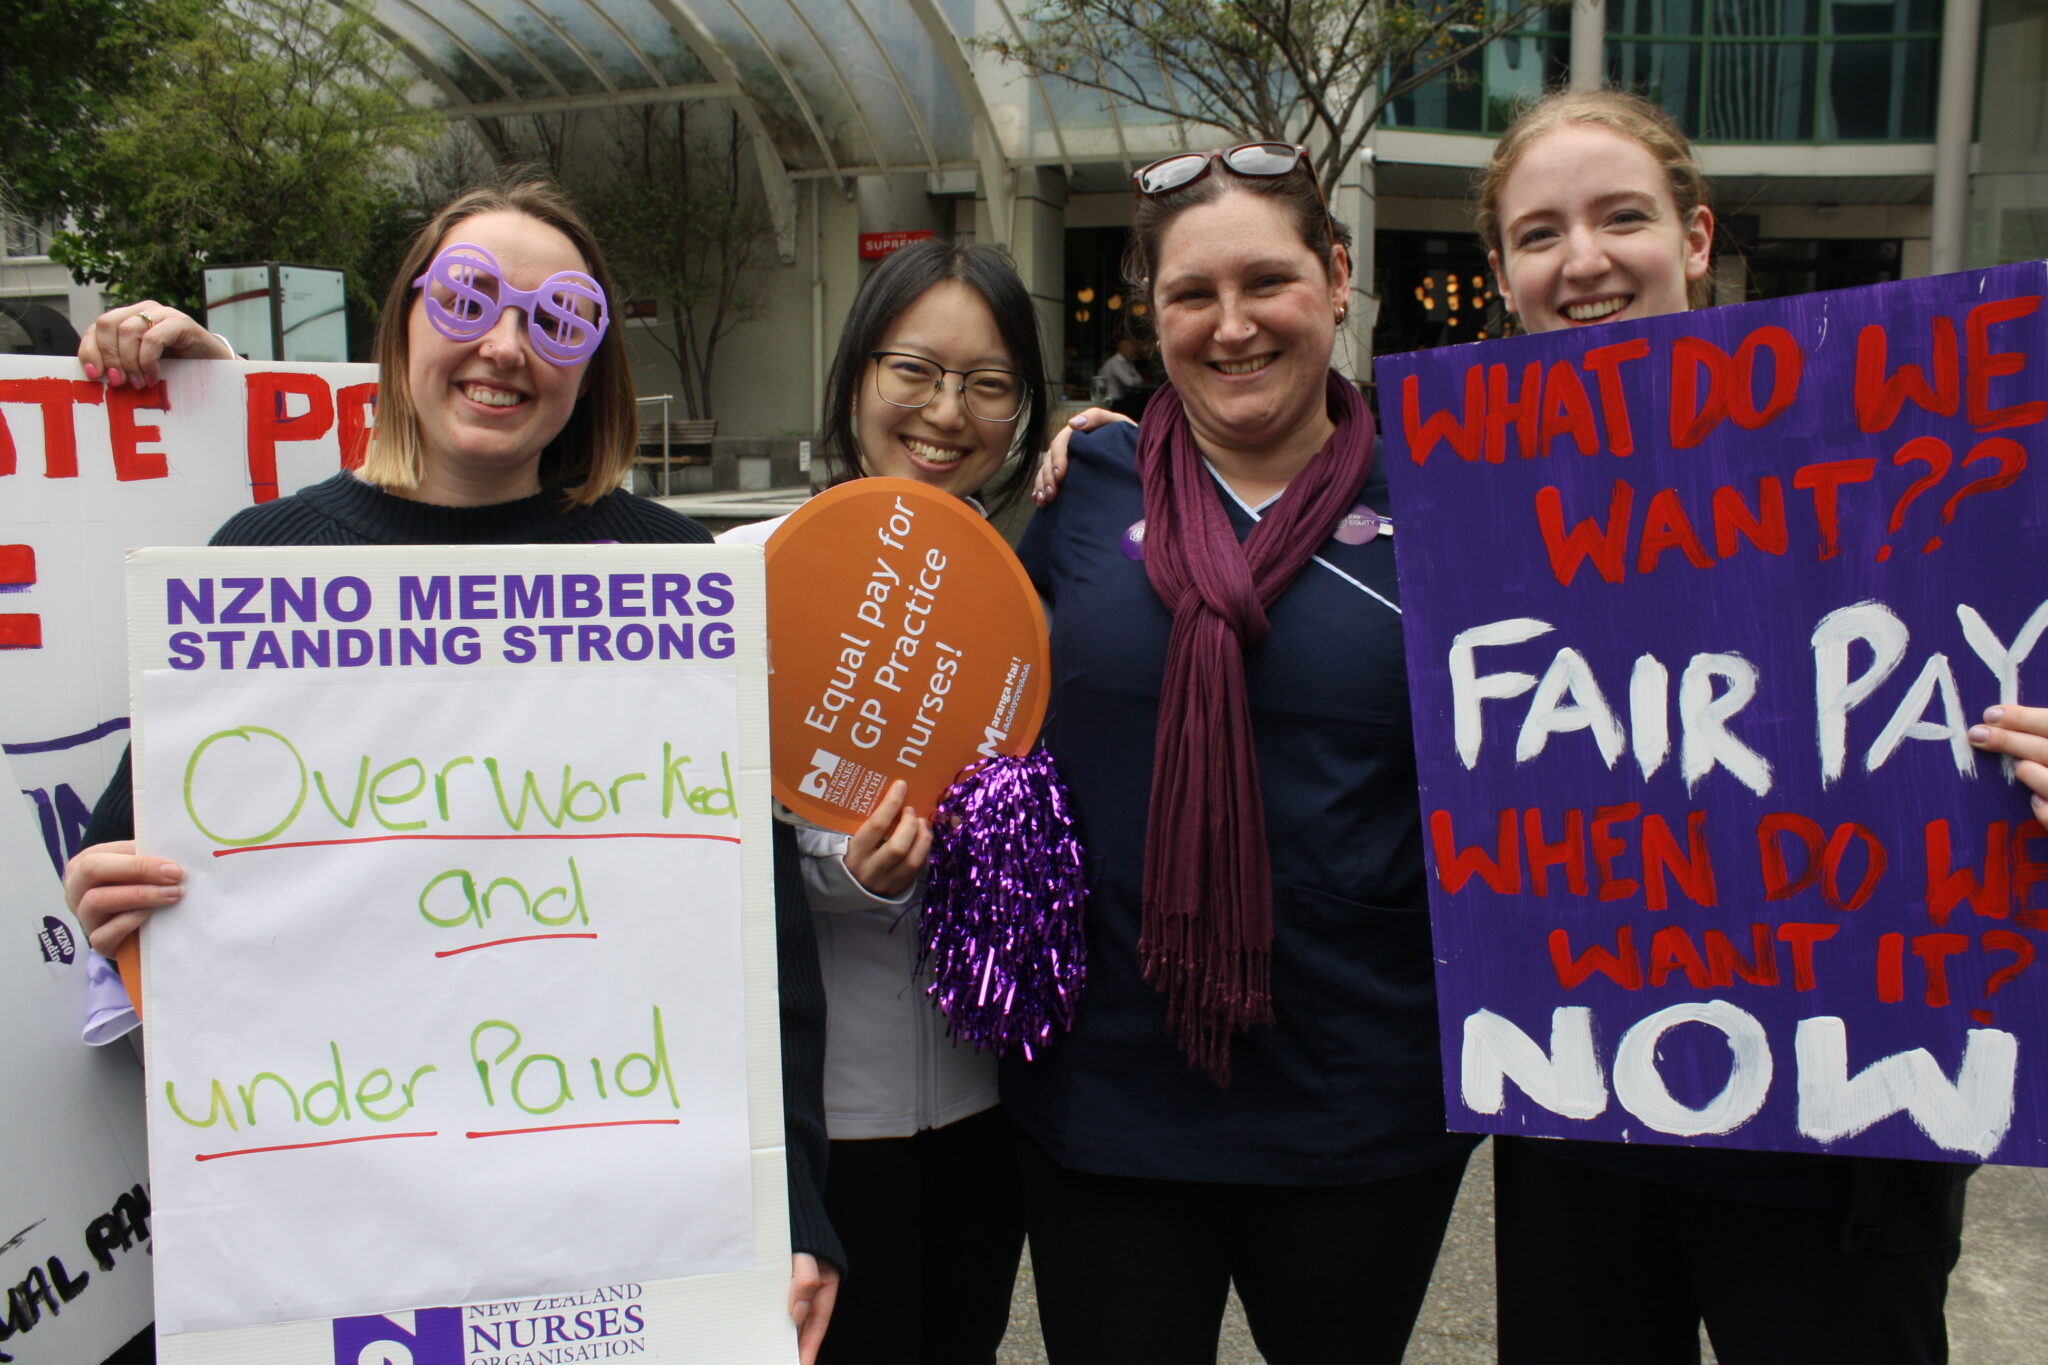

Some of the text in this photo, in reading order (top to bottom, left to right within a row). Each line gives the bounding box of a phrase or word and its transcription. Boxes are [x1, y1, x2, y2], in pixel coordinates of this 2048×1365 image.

[0, 379, 171, 481] TE
[1403, 295, 2048, 465] WHAT DO WE
[1535, 436, 2028, 587] WANT??
[166, 572, 735, 626] NZNO MEMBERS
[167, 622, 736, 671] STANDING STRONG
[804, 495, 916, 733] Equal pay for
[850, 548, 947, 749] GP Practice
[896, 641, 963, 768] nurses!
[976, 686, 1011, 759] Maranga
[1448, 599, 2048, 799] FAIR PAY
[831, 761, 855, 805] NURSES
[857, 773, 883, 814] TAPUHI
[418, 855, 590, 930] and
[1430, 801, 1718, 911] WHEN
[1756, 813, 1887, 911] DO
[54, 926, 73, 955] NZNO
[1548, 922, 2036, 1026] WANT IT?
[166, 1004, 680, 1132] under Paid
[1461, 1000, 2018, 1160] NOW
[468, 1301, 522, 1319] NEW
[469, 1304, 646, 1354] NURSES
